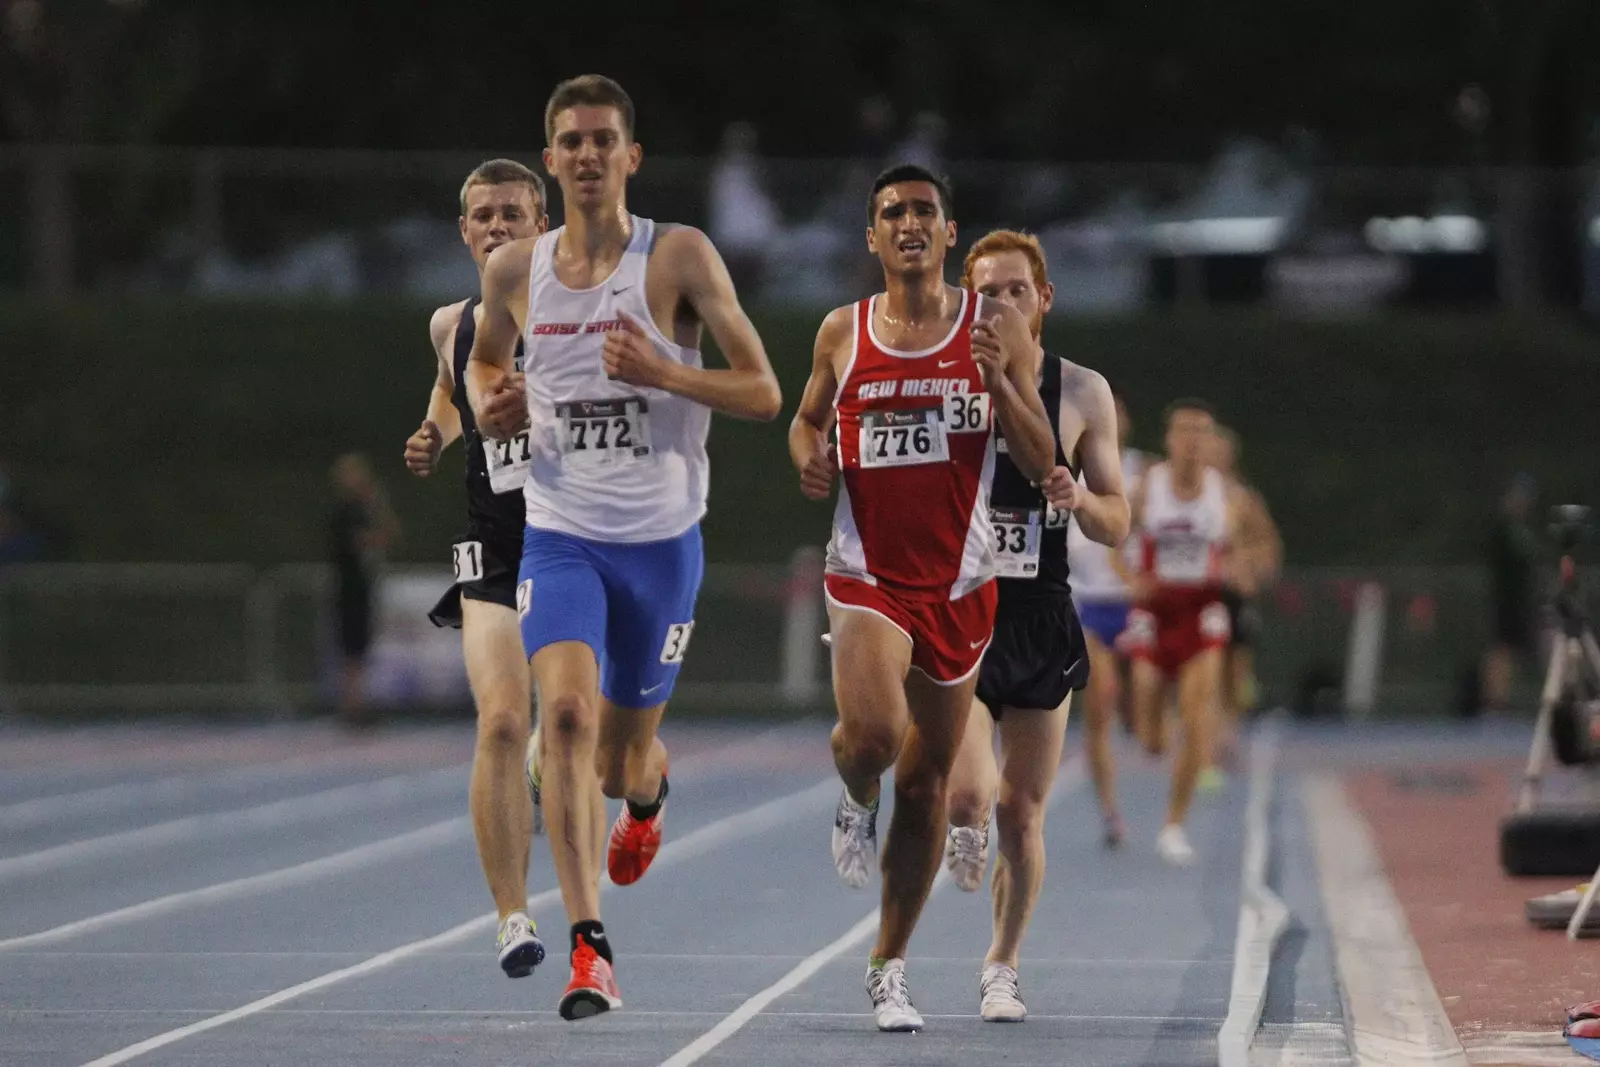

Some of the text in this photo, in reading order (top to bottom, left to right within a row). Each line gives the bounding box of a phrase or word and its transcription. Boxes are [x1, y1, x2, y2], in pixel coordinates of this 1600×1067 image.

[533, 322, 581, 335] BOISE
[858, 378, 970, 399] NEW MEXICO
[950, 395, 981, 430] 36
[569, 417, 633, 450] 772
[872, 426, 931, 457] 776
[665, 624, 692, 660] 3
